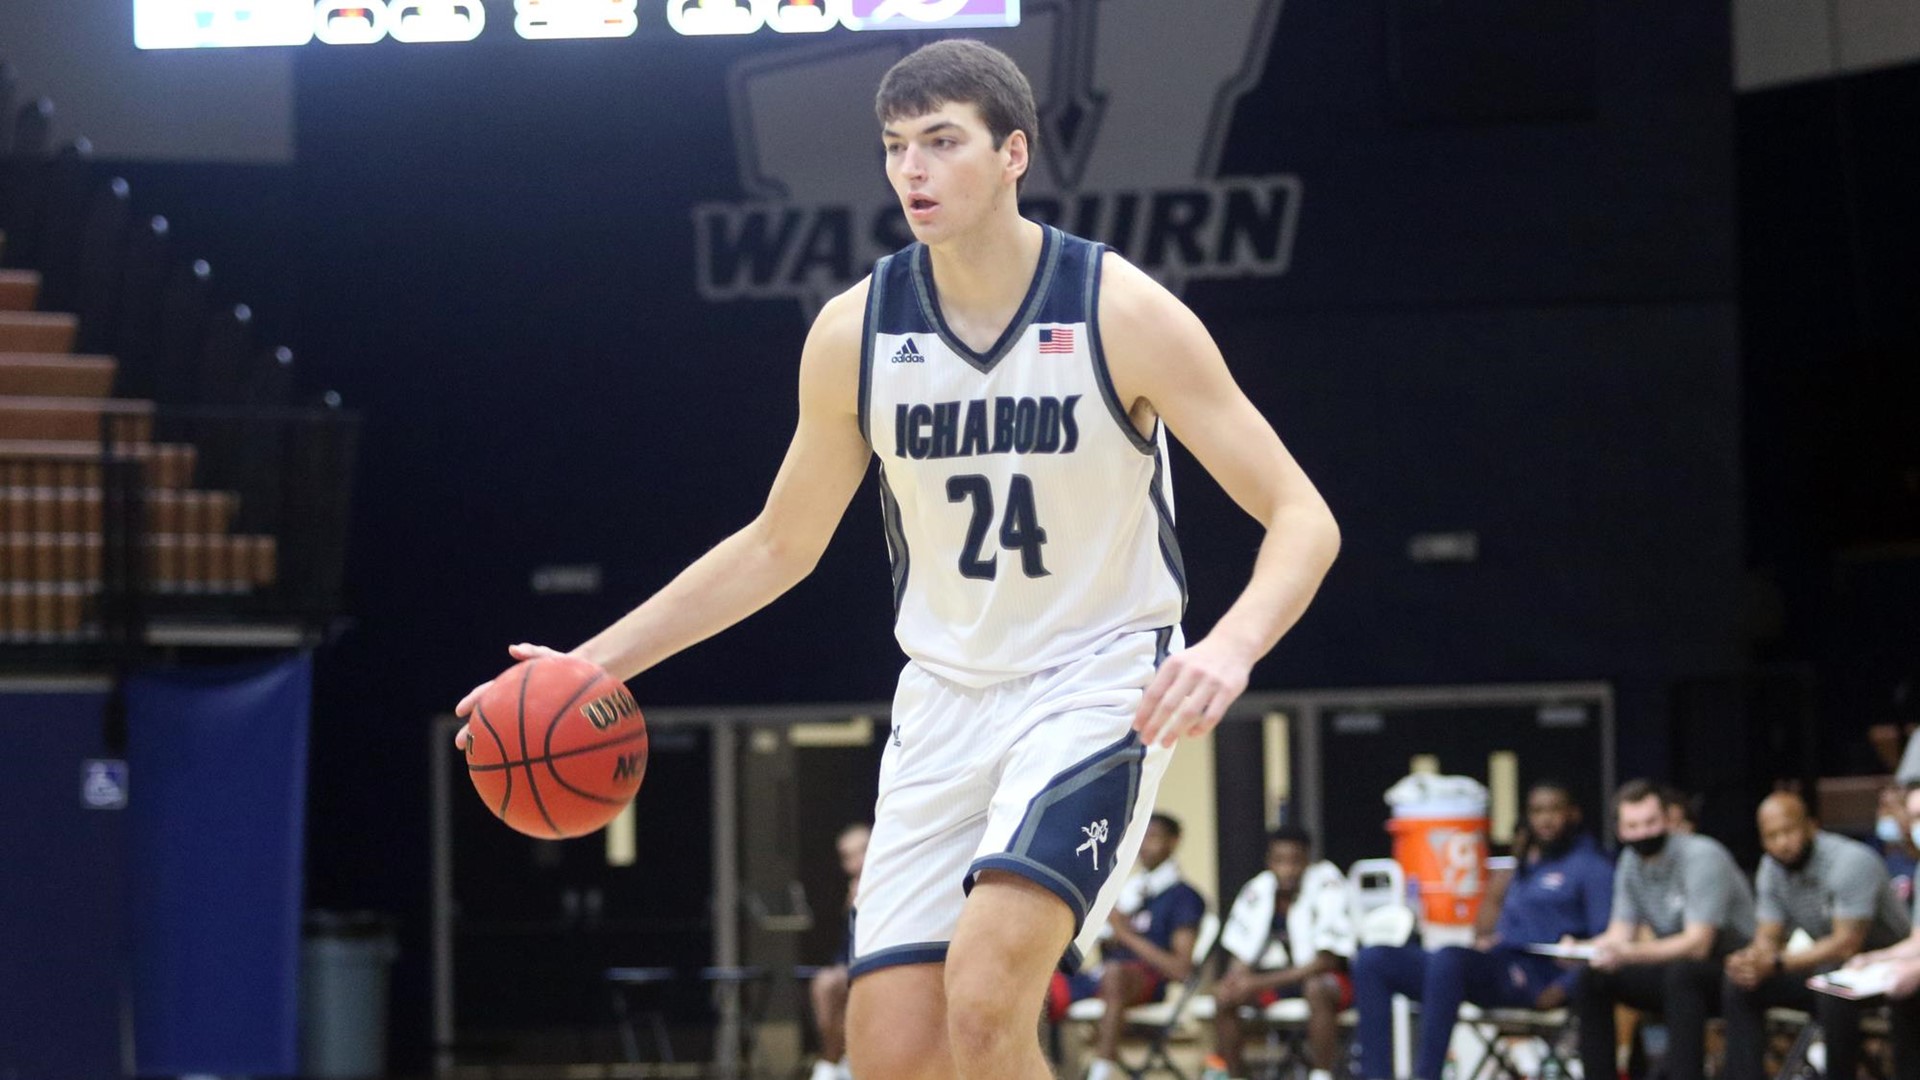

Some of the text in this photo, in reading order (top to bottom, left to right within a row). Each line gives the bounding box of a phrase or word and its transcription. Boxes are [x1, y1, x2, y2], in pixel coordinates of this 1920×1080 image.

[698, 177, 1298, 297] WASURN
[891, 353, 925, 363] adidas
[895, 394, 1083, 460] ICHABODS
[946, 473, 1051, 581] 24
